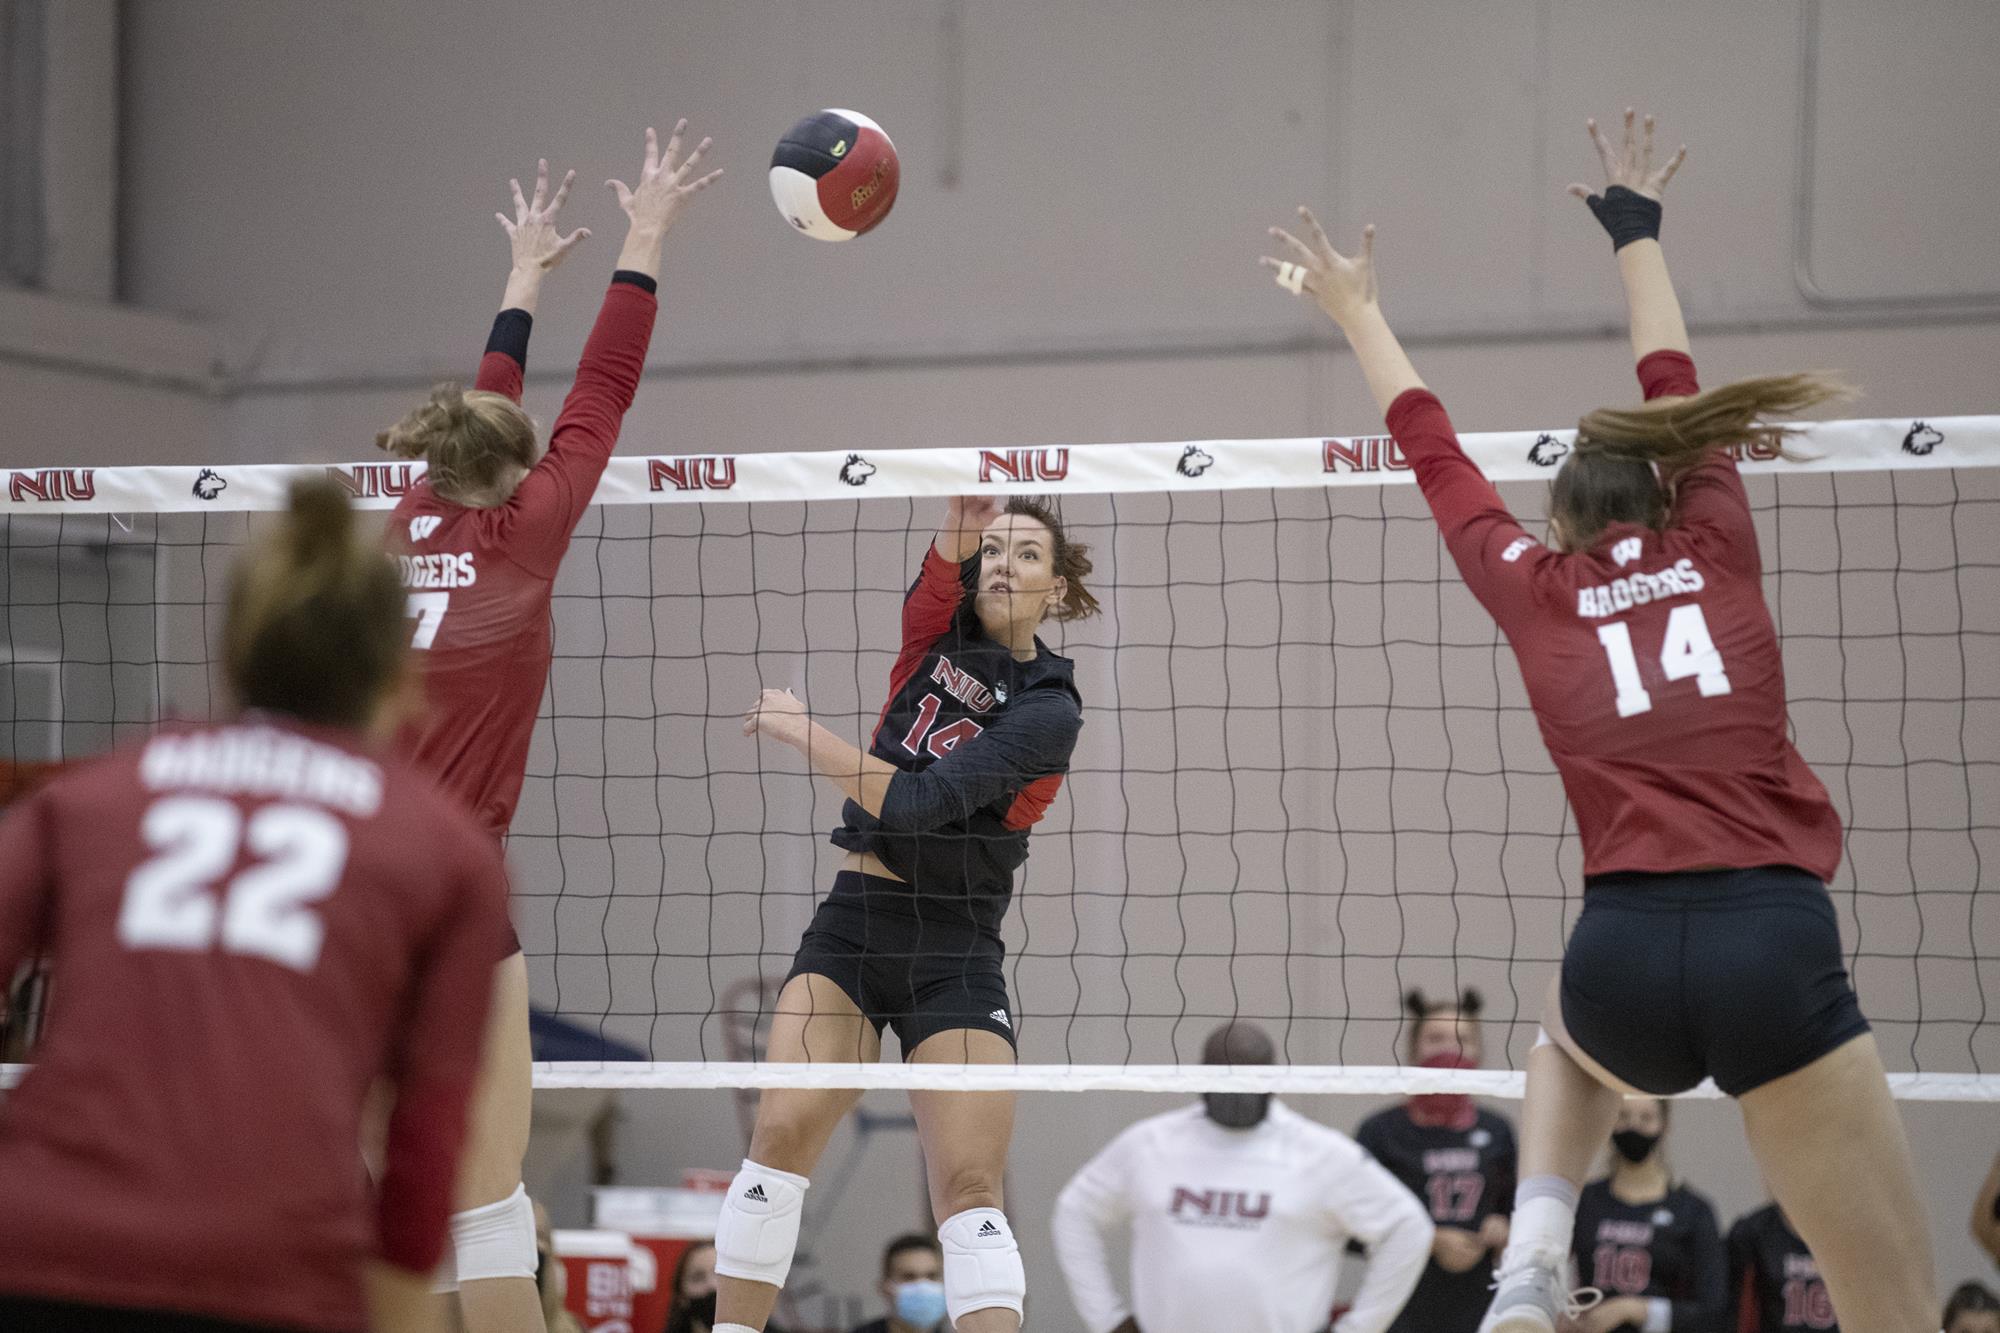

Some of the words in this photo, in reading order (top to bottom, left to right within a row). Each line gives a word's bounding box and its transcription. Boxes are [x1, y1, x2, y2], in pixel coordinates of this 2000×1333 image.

[8, 469, 96, 502] NIU
[647, 457, 736, 492] NIU
[978, 448, 1069, 483] NIU
[399, 552, 477, 589] DGERS
[1577, 557, 1705, 618] BADGERS
[403, 591, 450, 650] 7
[930, 655, 996, 713] NIU
[1597, 603, 1732, 719] 14
[117, 795, 350, 974] 22
[1169, 1186, 1271, 1219] NIU
[1424, 1170, 1486, 1222] 17
